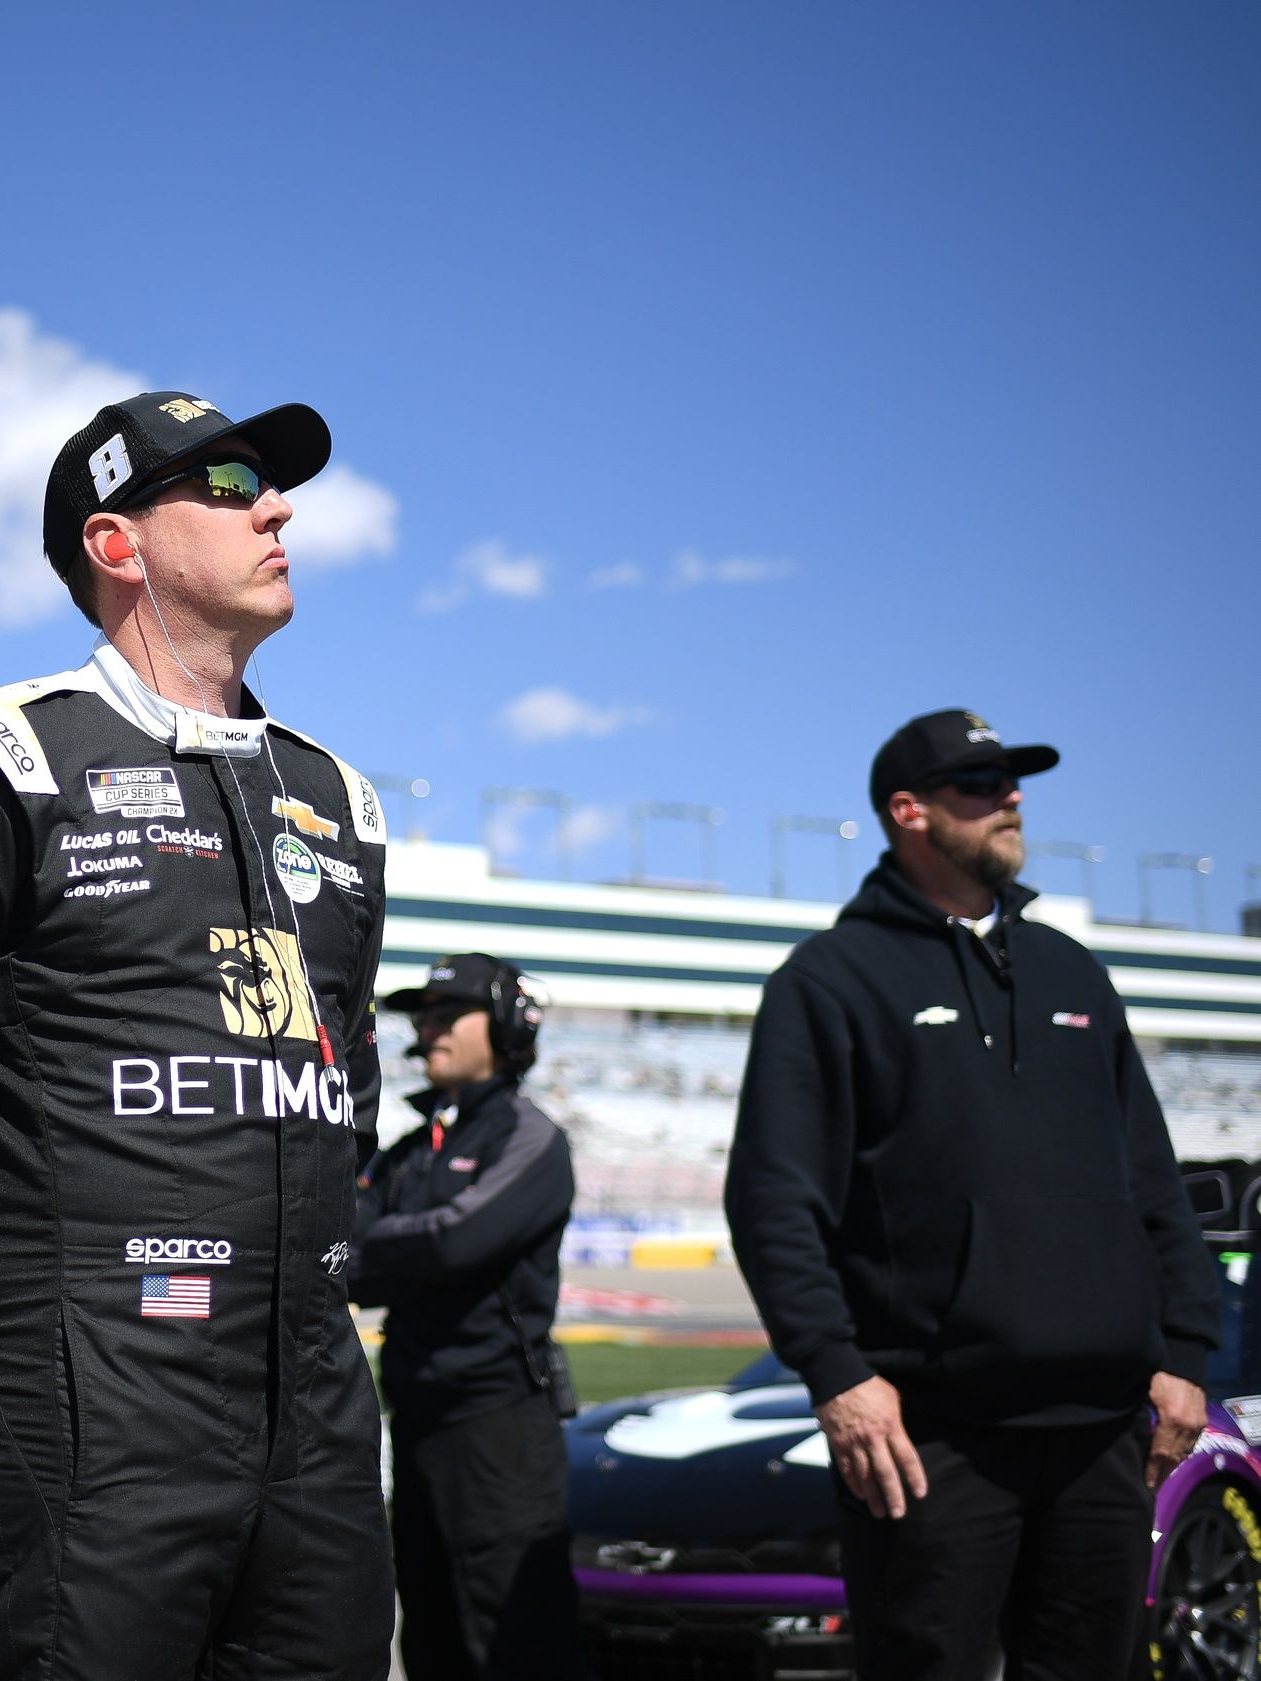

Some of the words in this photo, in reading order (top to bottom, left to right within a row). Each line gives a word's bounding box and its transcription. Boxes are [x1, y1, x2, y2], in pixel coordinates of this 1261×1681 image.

[89, 433, 133, 503] 8
[205, 730, 248, 742] BETMGM
[116, 771, 162, 784] NASCAR
[105, 789, 128, 802] CUP
[131, 788, 168, 800] SERIES
[127, 806, 167, 816] CHAMPION
[169, 807, 178, 815] 2X
[60, 832, 113, 850] LUCAS
[116, 829, 141, 845] OIL
[146, 824, 223, 851] Cheddar's
[64, 879, 151, 898] GOODYEAR
[125, 1238, 231, 1264] sparco
